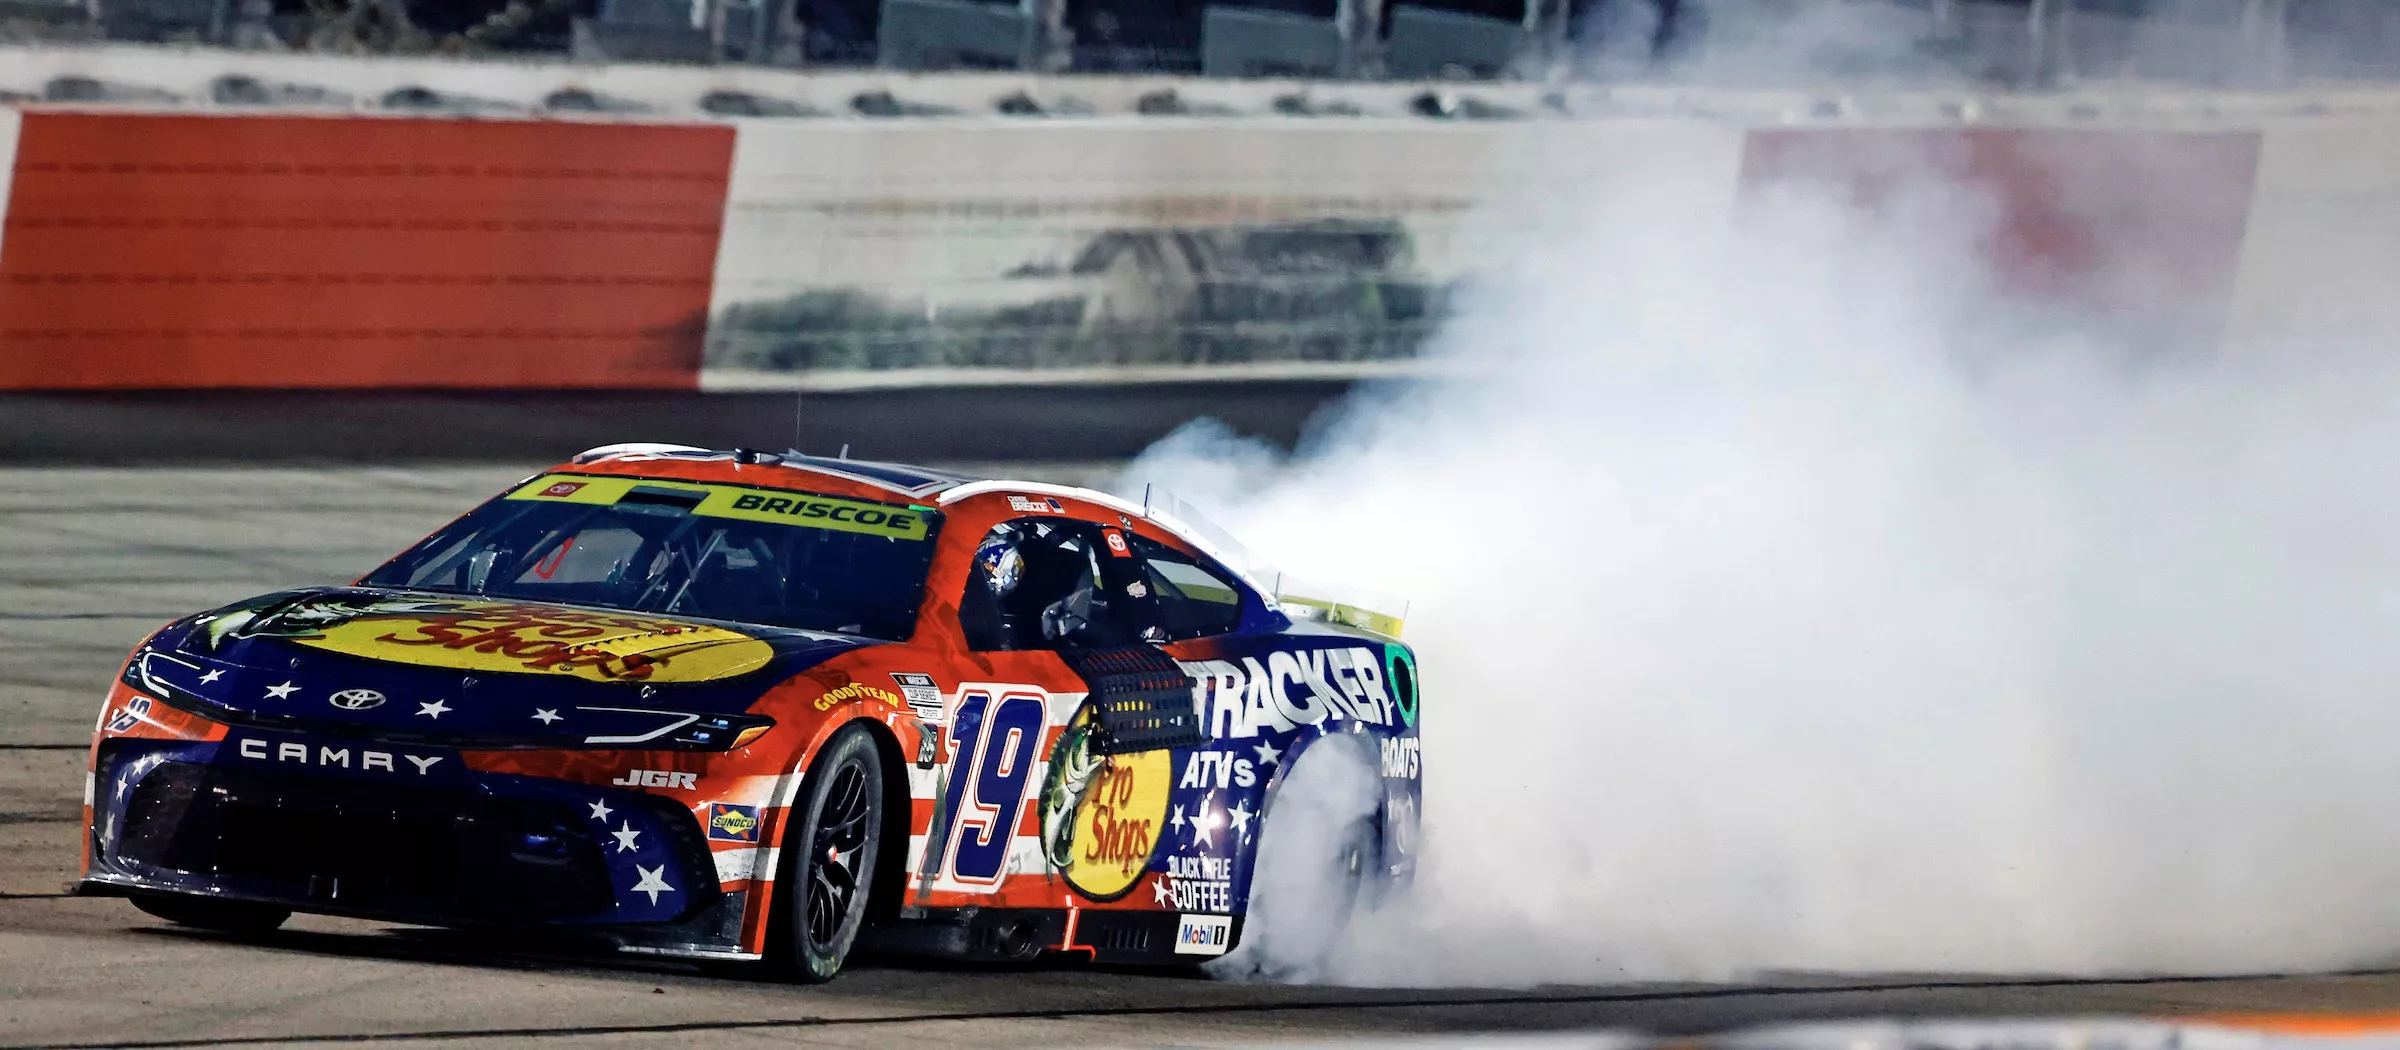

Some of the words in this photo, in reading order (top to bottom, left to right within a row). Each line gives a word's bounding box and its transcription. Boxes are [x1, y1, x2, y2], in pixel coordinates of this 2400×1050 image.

[731, 494, 915, 530] BRISCOE
[814, 682, 899, 712] GOODYEAR
[1173, 648, 1393, 739] TRACKER
[240, 738, 444, 775] CAMRY
[1179, 750, 1257, 789] ATVs
[1381, 736, 1420, 780] BOATS
[612, 769, 699, 791] JGR
[916, 689, 1048, 885] 19
[712, 816, 755, 831] SUNOCO
[1087, 805, 1150, 873] Shops
[1167, 856, 1201, 879] BLACK
[1171, 879, 1231, 912] COFFEE
[1182, 924, 1213, 945] Mobil
[1215, 926, 1225, 945] 1
